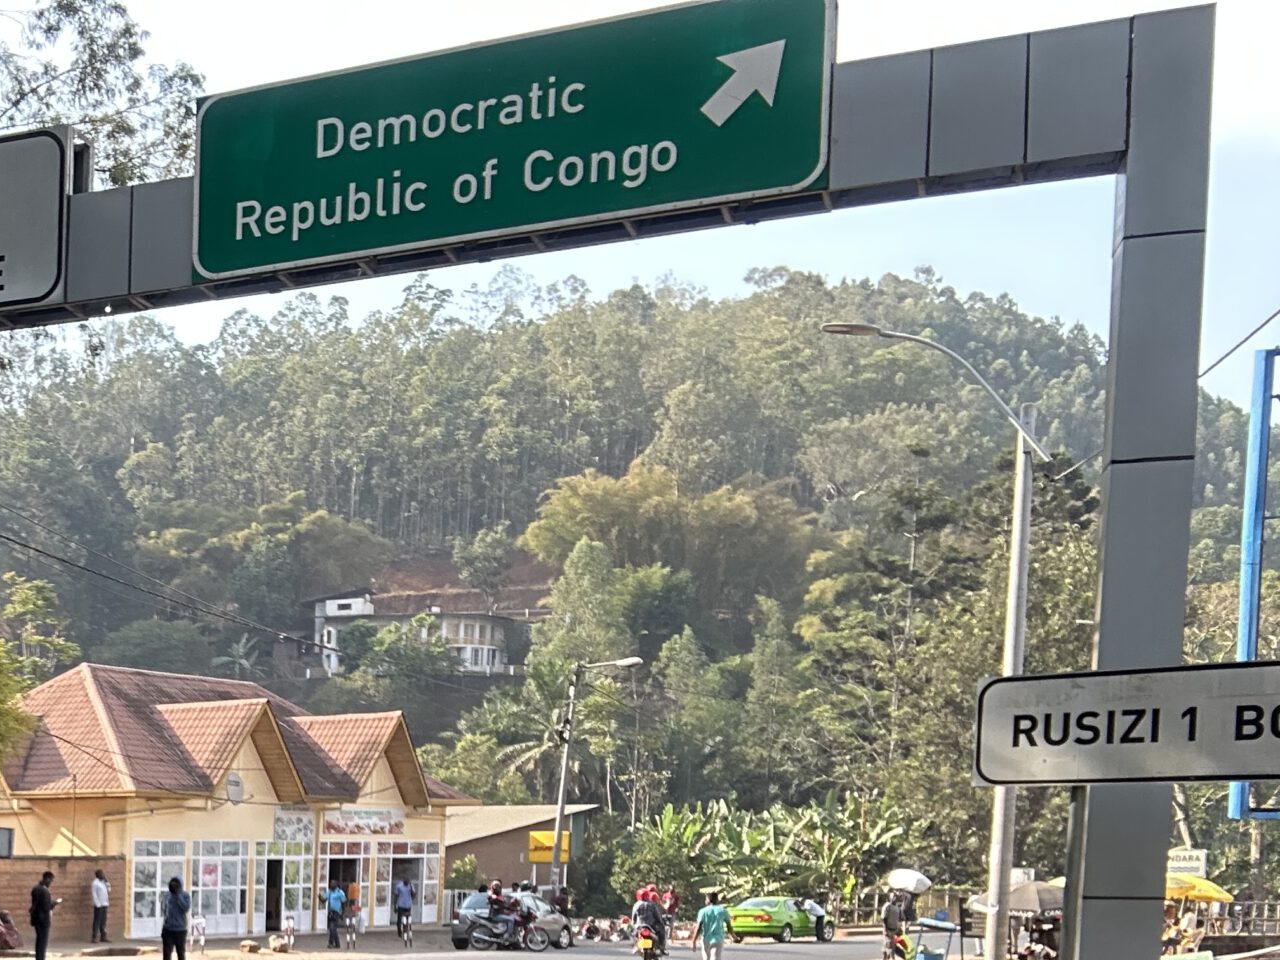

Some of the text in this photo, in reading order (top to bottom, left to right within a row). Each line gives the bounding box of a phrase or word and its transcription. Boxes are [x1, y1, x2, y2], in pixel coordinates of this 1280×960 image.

[316, 76, 586, 159] Democratic
[234, 140, 678, 241] Republic of Congo
[1012, 708, 1160, 747] RUSIZI
[1181, 706, 1197, 741] 1
